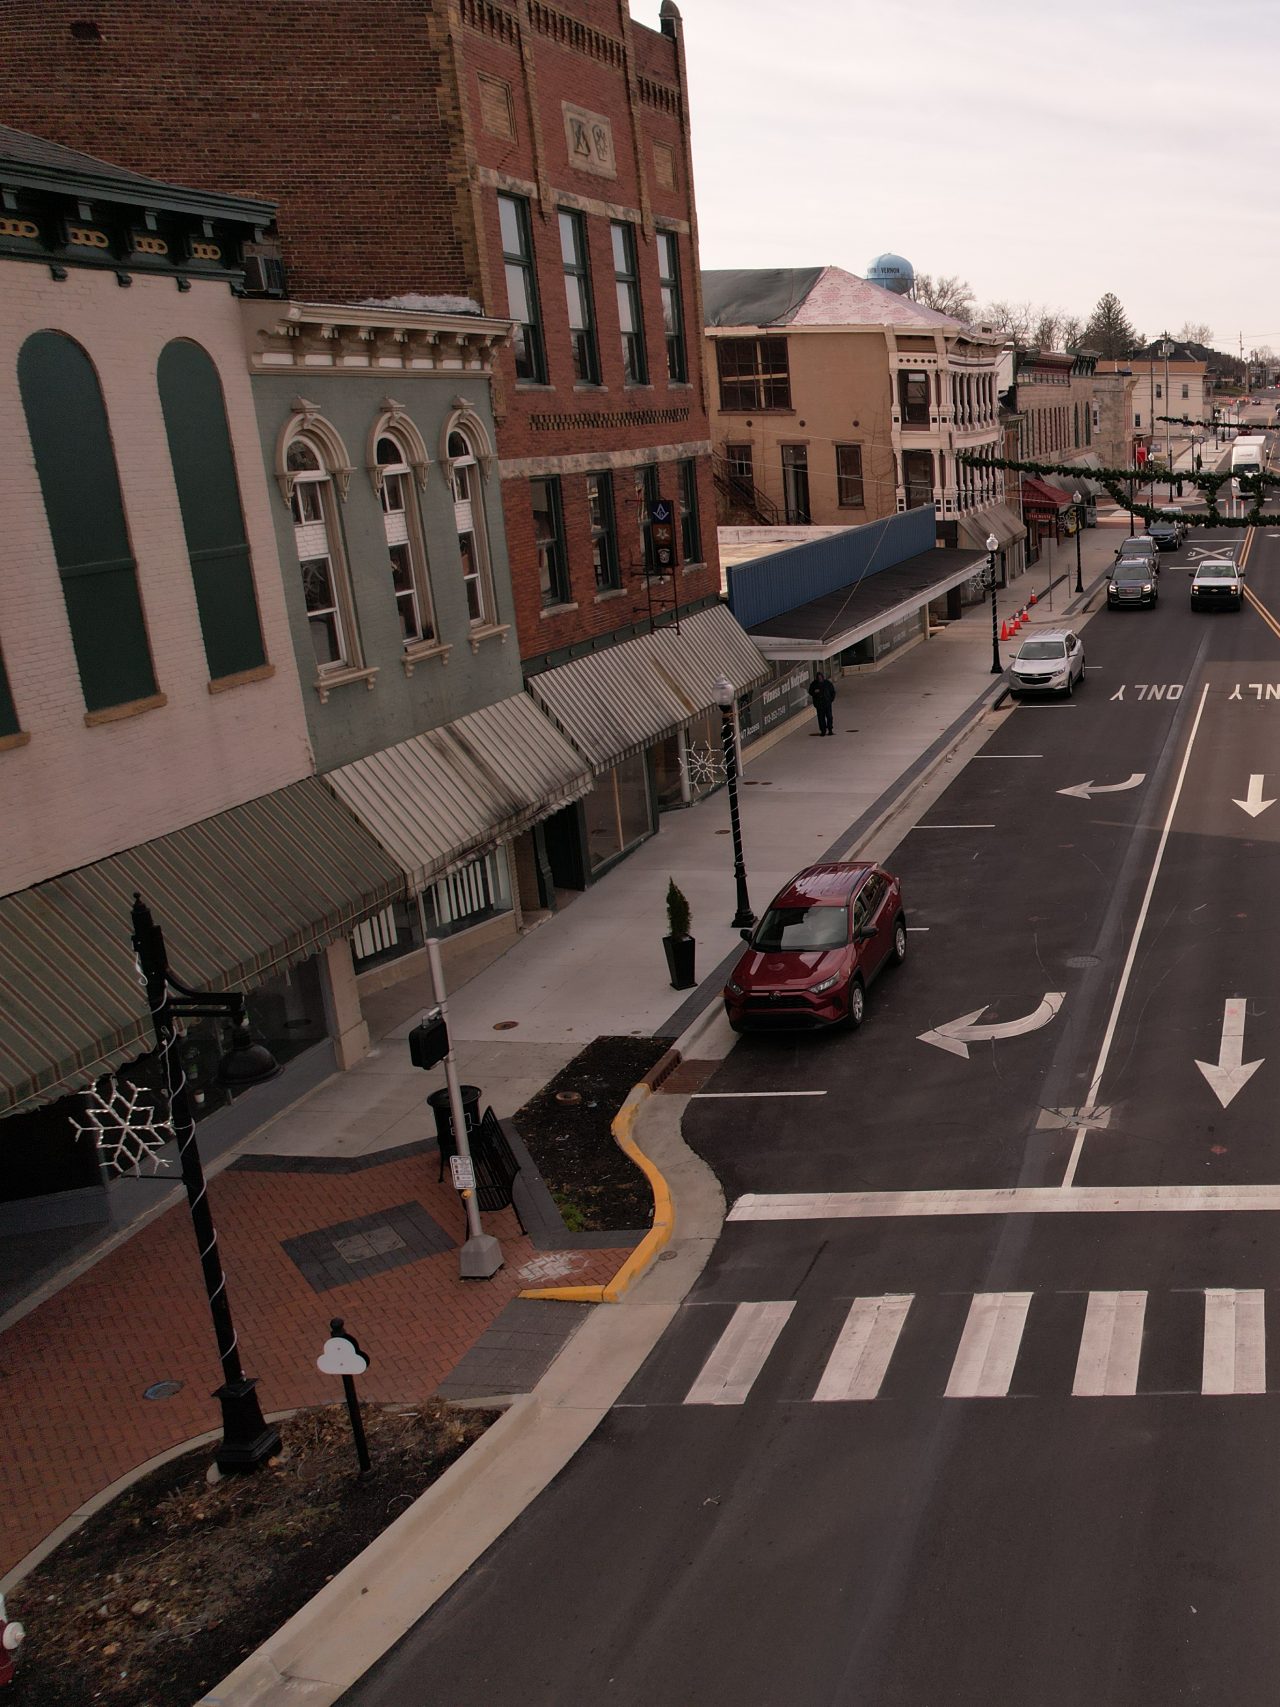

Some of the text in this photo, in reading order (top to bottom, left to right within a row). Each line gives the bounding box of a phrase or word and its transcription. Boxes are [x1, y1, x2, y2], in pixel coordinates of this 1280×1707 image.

[763, 670, 809, 705] Fitness and Nutrition
[1109, 684, 1184, 701] ONLY
[747, 723, 760, 735] Access
